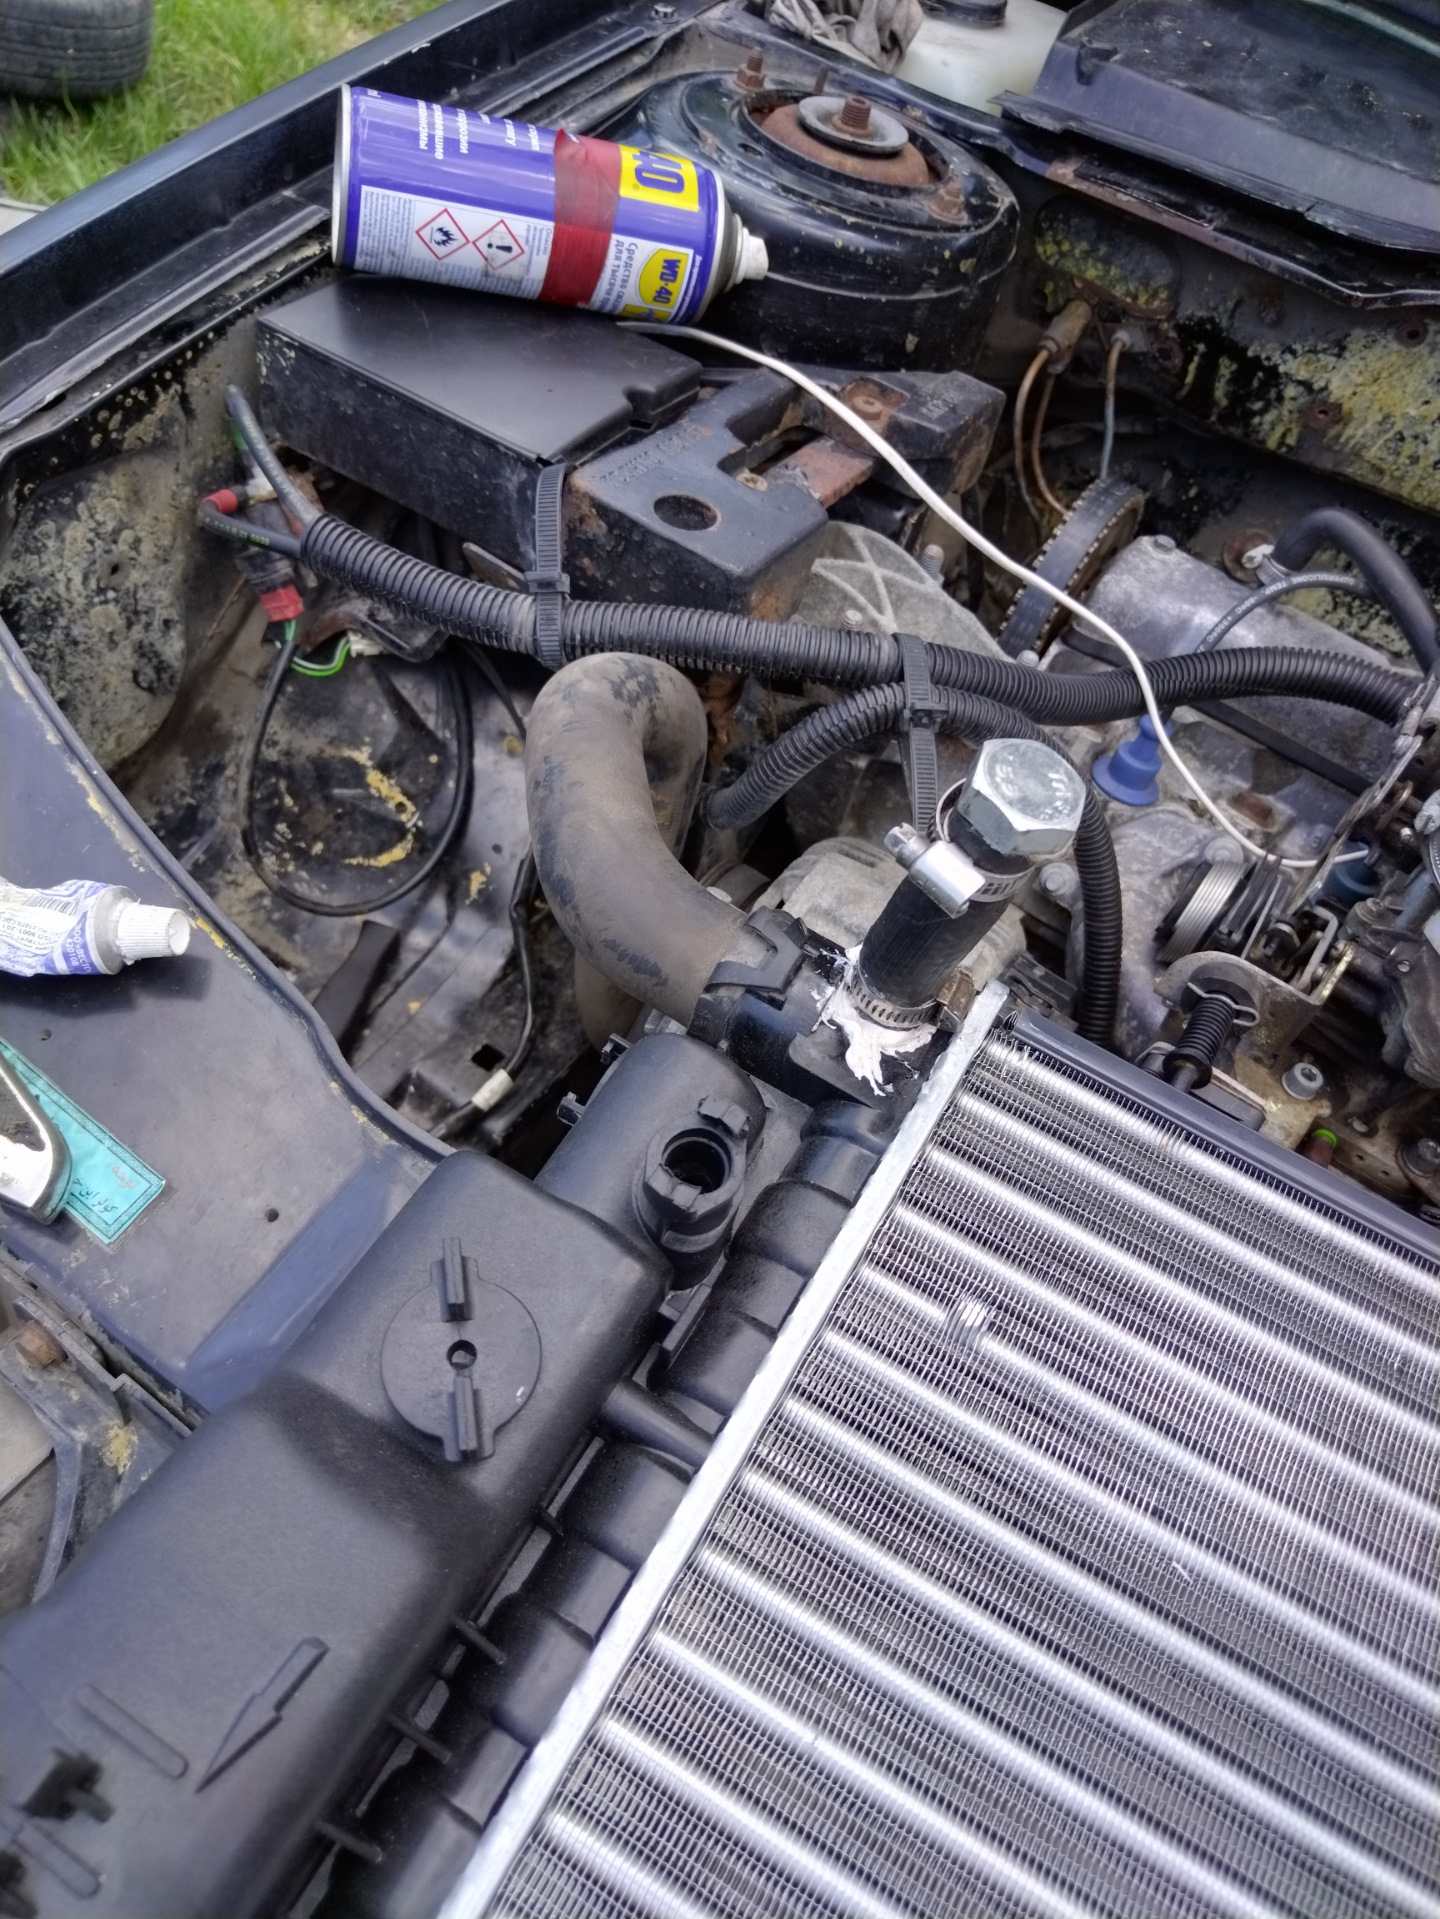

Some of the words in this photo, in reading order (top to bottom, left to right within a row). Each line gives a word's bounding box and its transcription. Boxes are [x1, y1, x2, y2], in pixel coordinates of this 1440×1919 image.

[613, 239, 625, 263] для
[622, 239, 639, 291] Средство
[652, 258, 681, 304] WD-40
[1261, 580, 1289, 596] TEMP.
[1290, 573, 1355, 586] SUPERSILICONE
